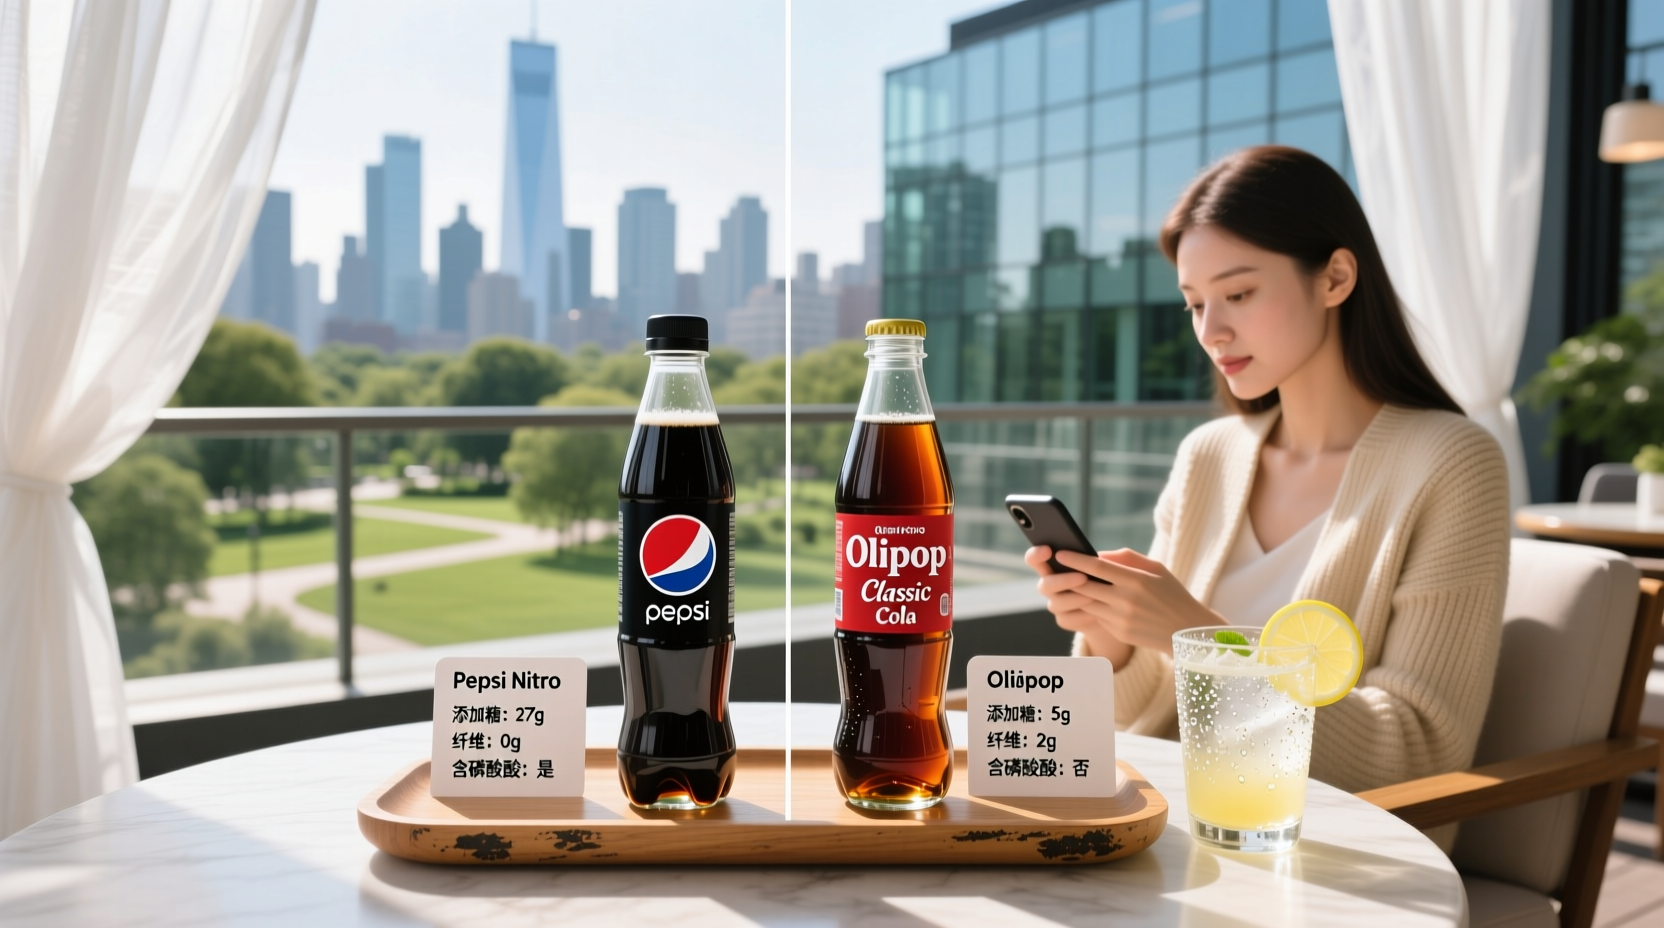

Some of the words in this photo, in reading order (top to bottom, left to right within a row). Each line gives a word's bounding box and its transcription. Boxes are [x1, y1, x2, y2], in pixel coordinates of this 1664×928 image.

[846, 534, 947, 577] Olipop
[861, 578, 932, 603] Classic
[645, 600, 710, 626] pepsi
[875, 605, 917, 625] Cola
[453, 670, 507, 694] Pepsi
[511, 670, 562, 690] Nitro
